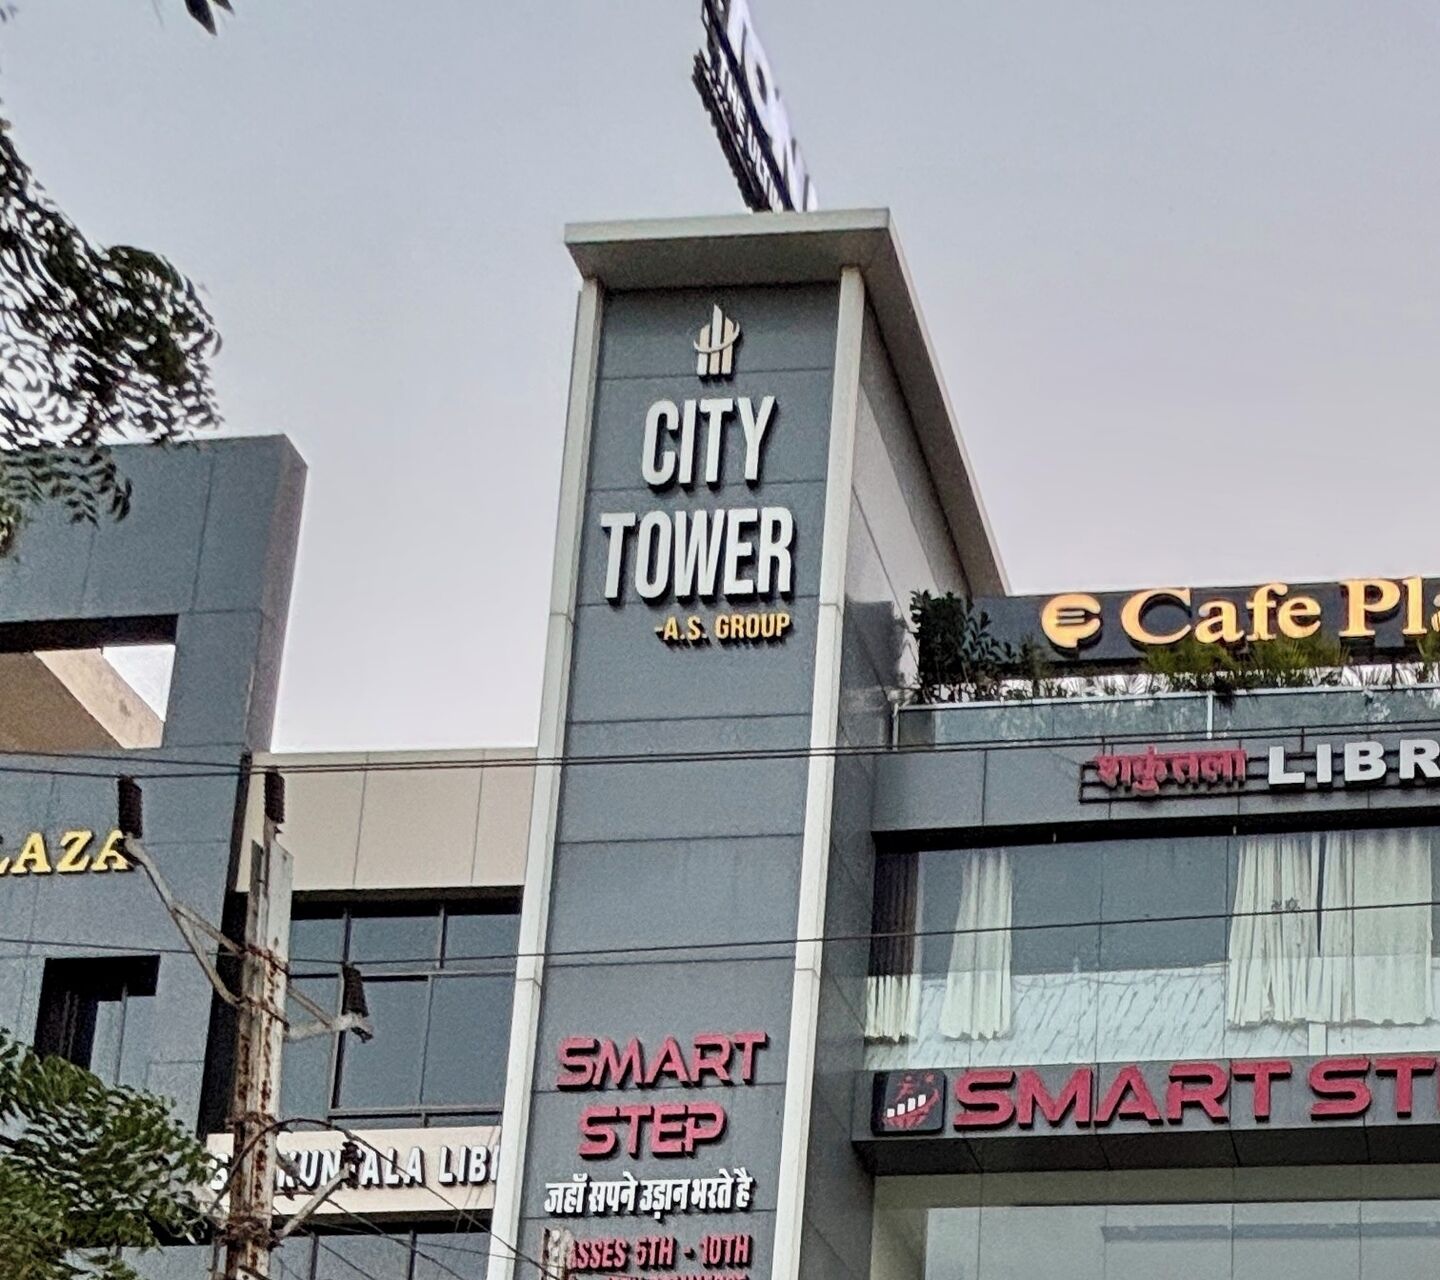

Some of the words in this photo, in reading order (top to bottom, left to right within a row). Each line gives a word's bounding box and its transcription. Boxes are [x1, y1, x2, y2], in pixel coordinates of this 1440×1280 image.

[641, 395, 777, 486] CITY
[600, 506, 794, 600] TOWER
[715, 612, 792, 639] GROUP
[1121, 587, 1322, 645] Cafe
[0, 829, 131, 873] AZA
[556, 1031, 768, 1089] SMART
[953, 1061, 1294, 1131] SMART
[577, 1101, 727, 1158] STEP
[438, 1144, 497, 1184] LIB
[588, 1171, 639, 1213] सपने
[639, 1178, 690, 1220] उड़ान
[691, 1169, 735, 1210] भरते
